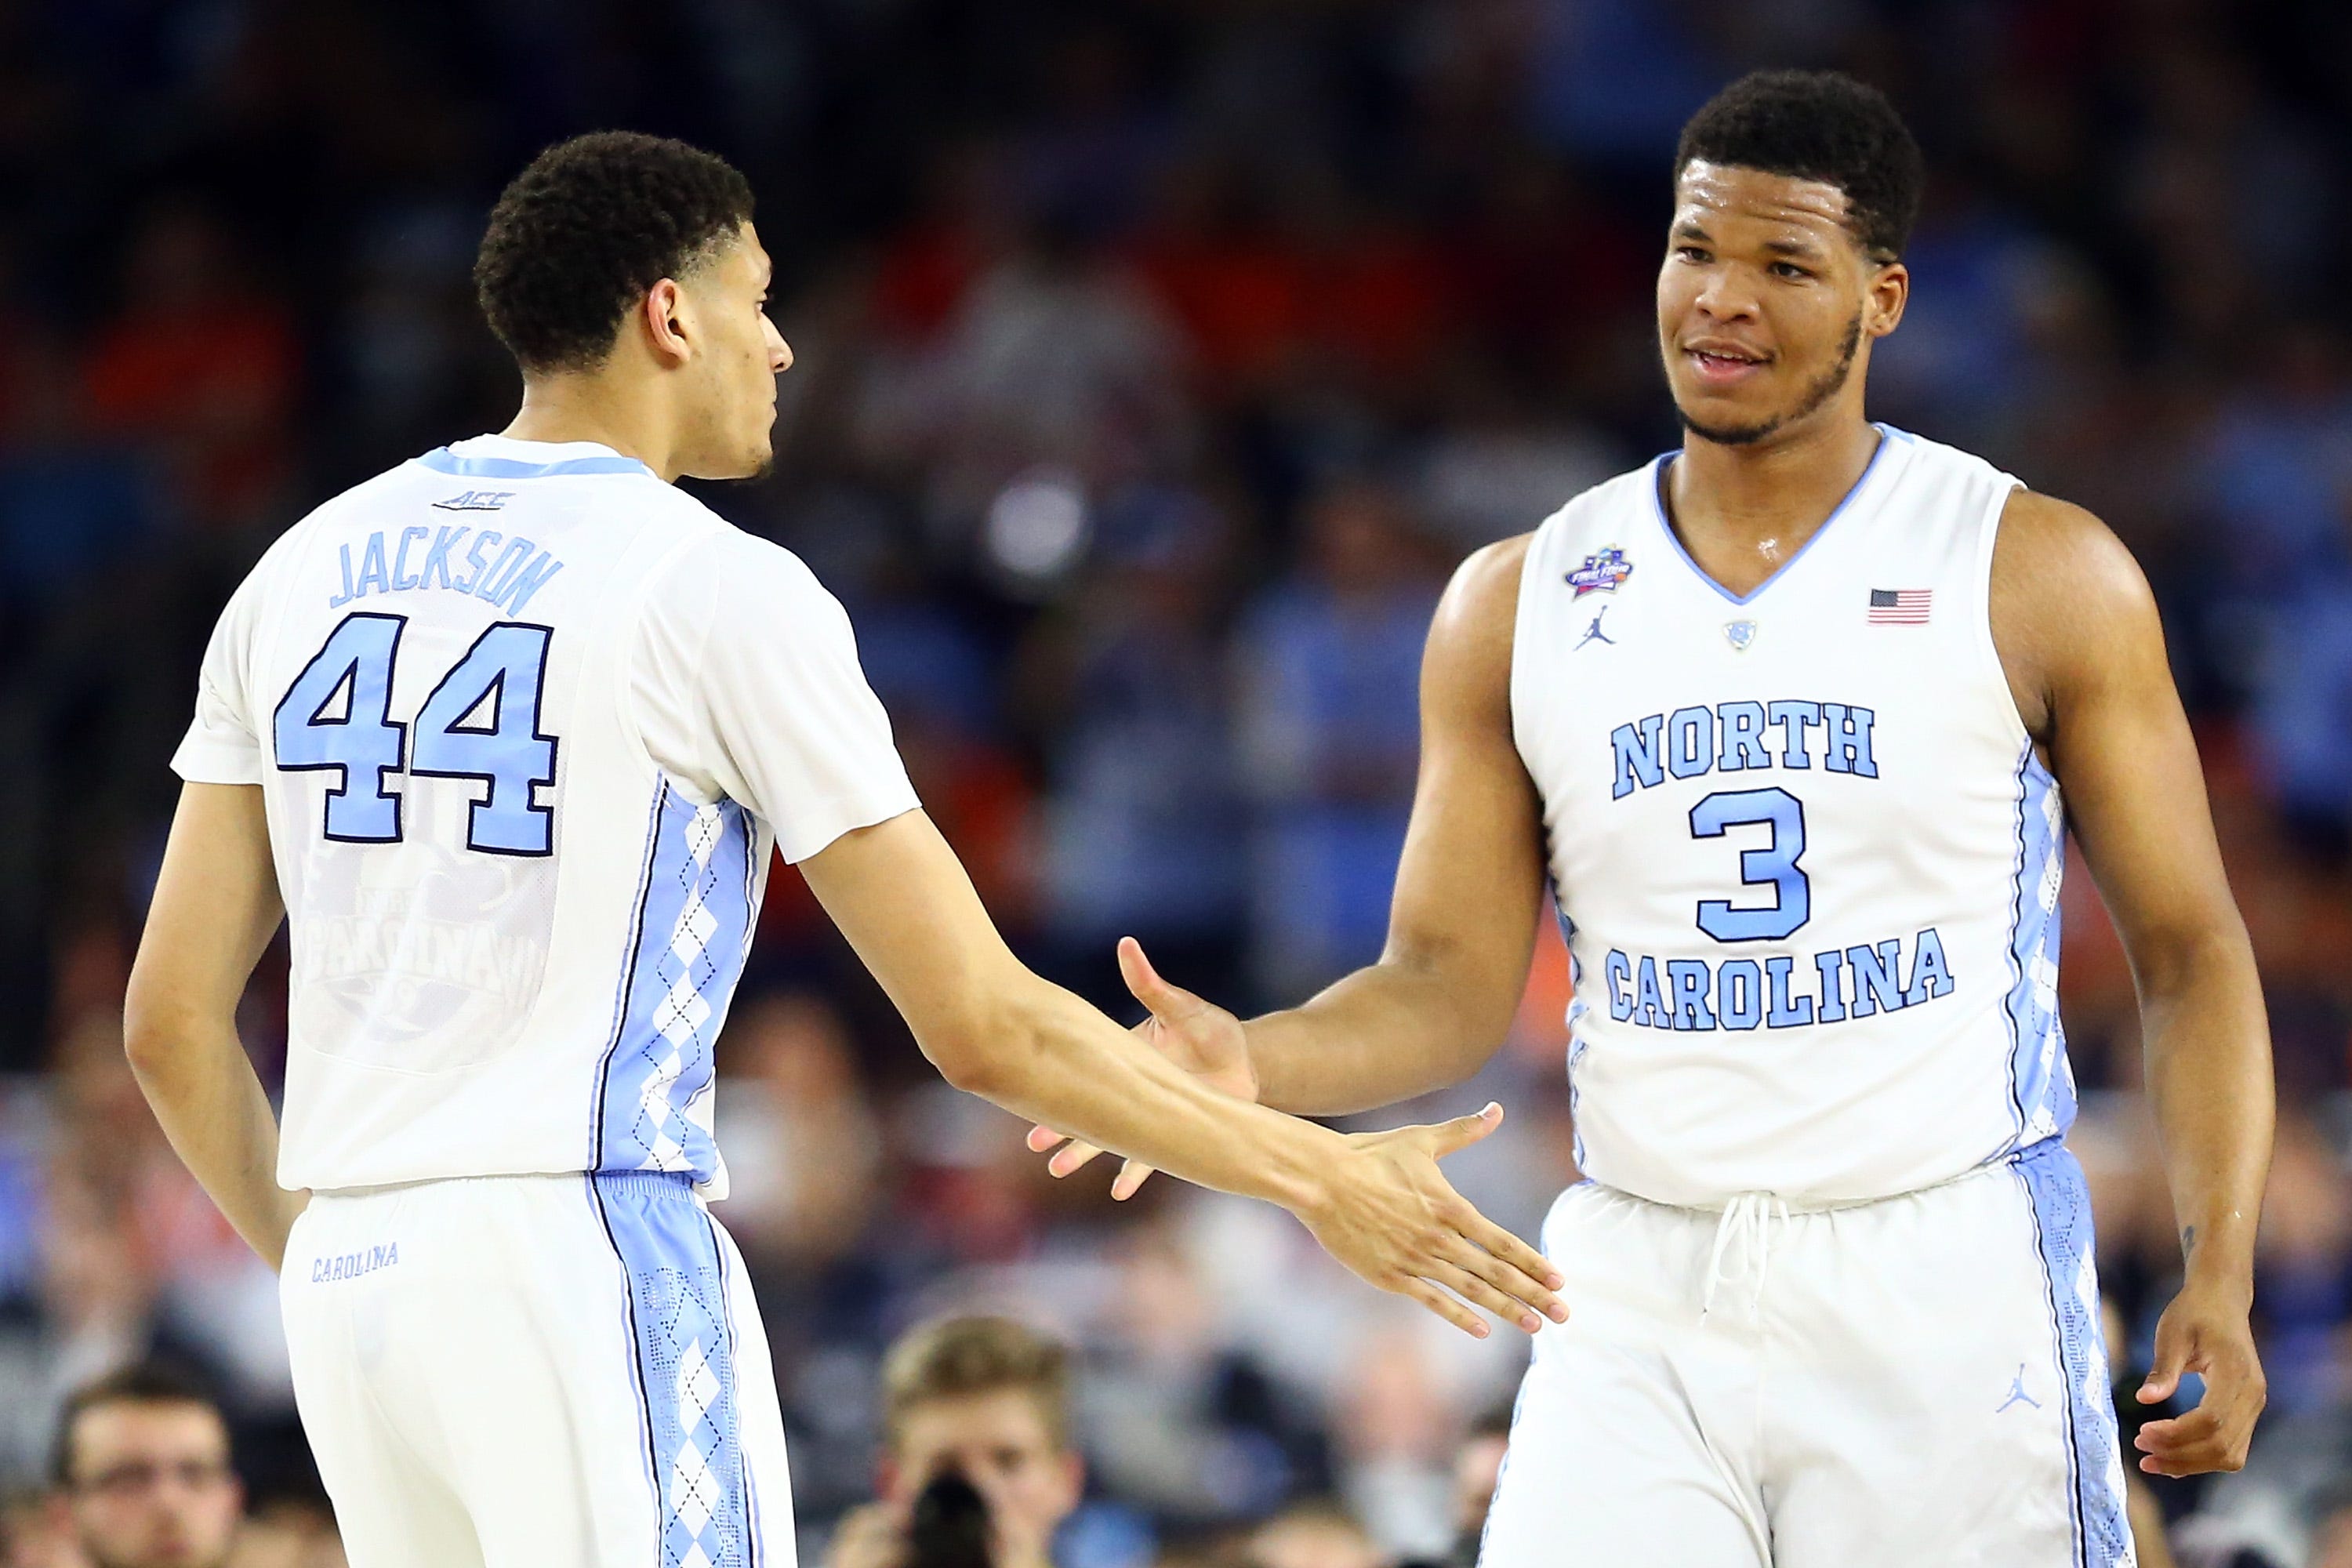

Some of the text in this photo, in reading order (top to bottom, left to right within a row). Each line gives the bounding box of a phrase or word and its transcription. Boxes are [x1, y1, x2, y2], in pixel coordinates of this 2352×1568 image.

[438, 490, 517, 508] ACC
[329, 525, 564, 618] JACKSON
[274, 612, 559, 857] 44
[1611, 699, 1880, 801] NORTH
[1689, 786, 1810, 943] 3
[1605, 927, 1955, 1032] CAROLINA
[312, 1241, 398, 1283] CAROLINA
